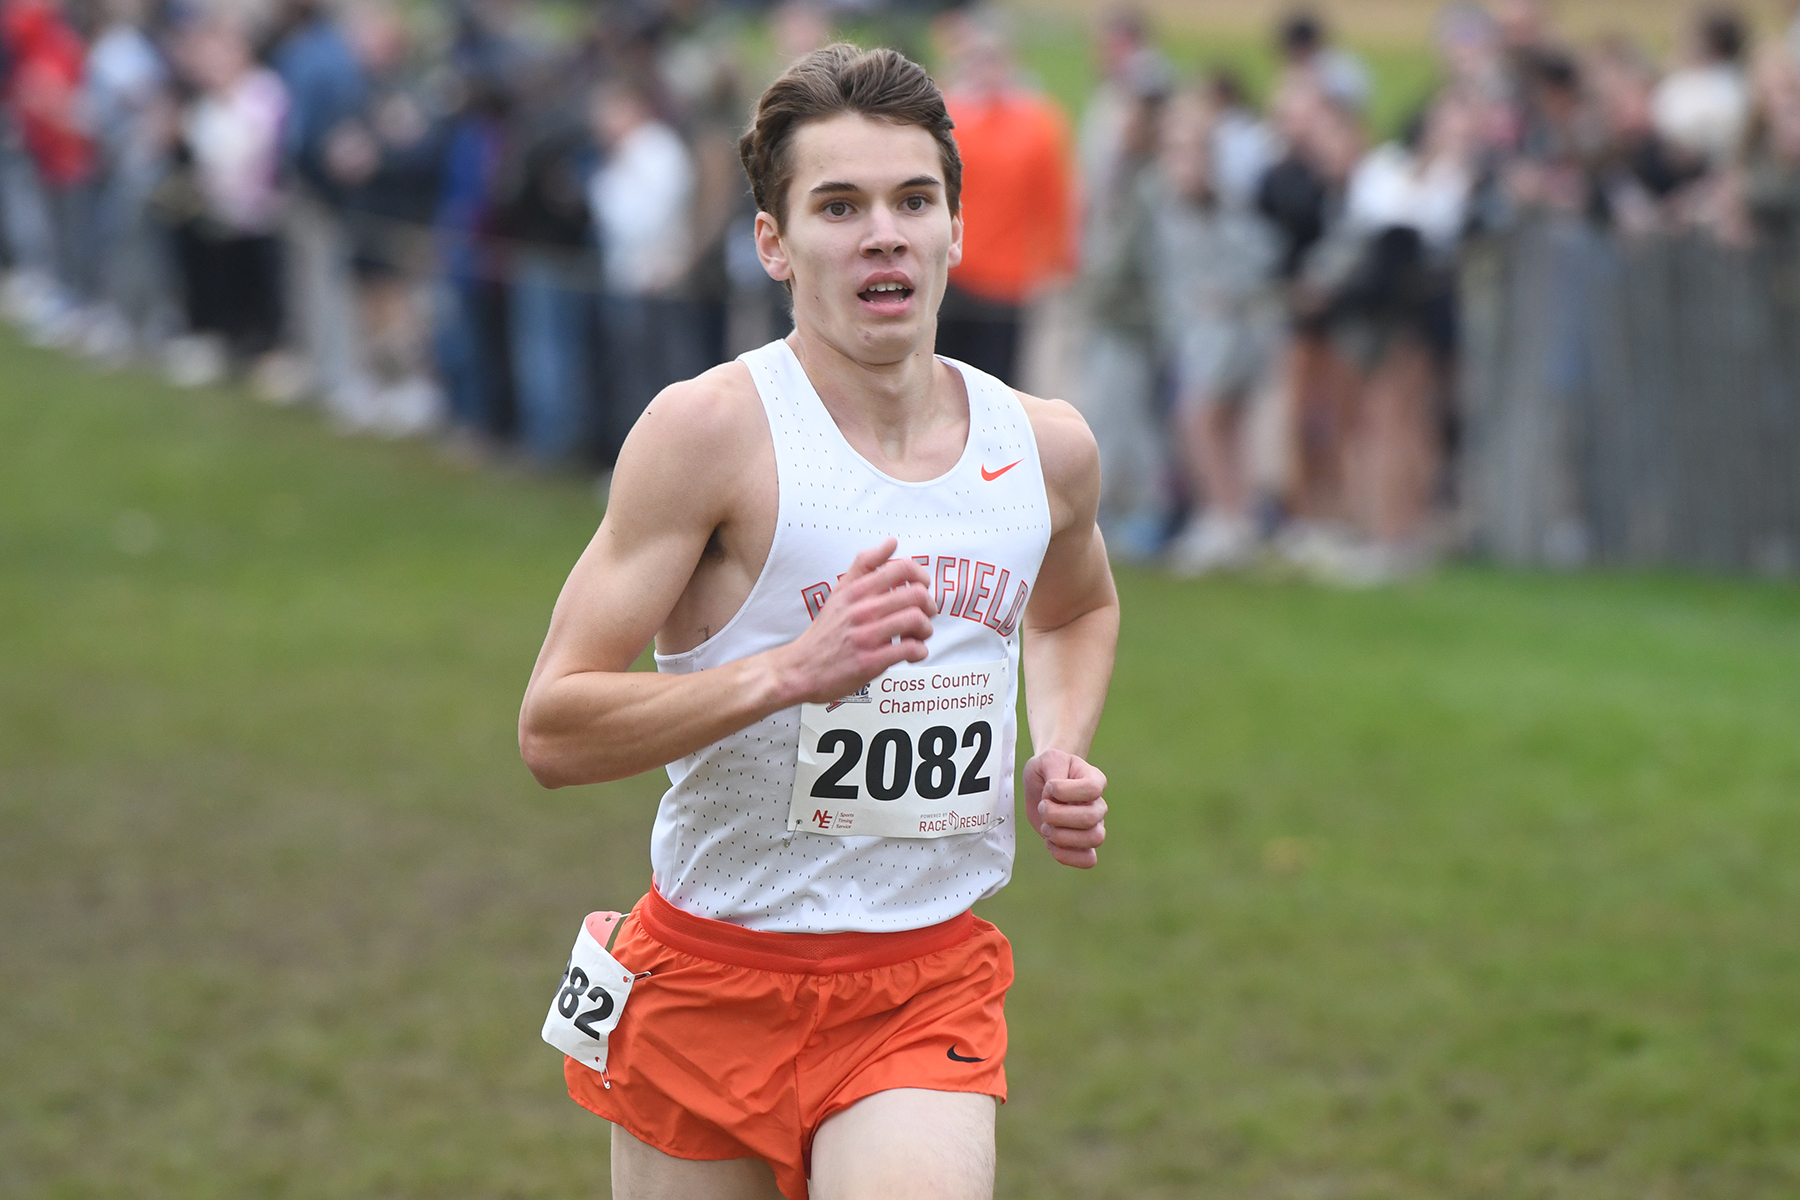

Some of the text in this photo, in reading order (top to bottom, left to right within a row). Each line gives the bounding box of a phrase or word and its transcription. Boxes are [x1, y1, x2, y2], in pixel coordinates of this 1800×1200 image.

[880, 677, 926, 693] Cross
[931, 671, 991, 689] Country
[878, 692, 995, 714] Championships
[809, 720, 993, 801] 2082
[919, 812, 991, 832] RACE RESULT
[555, 962, 615, 1041] 82
